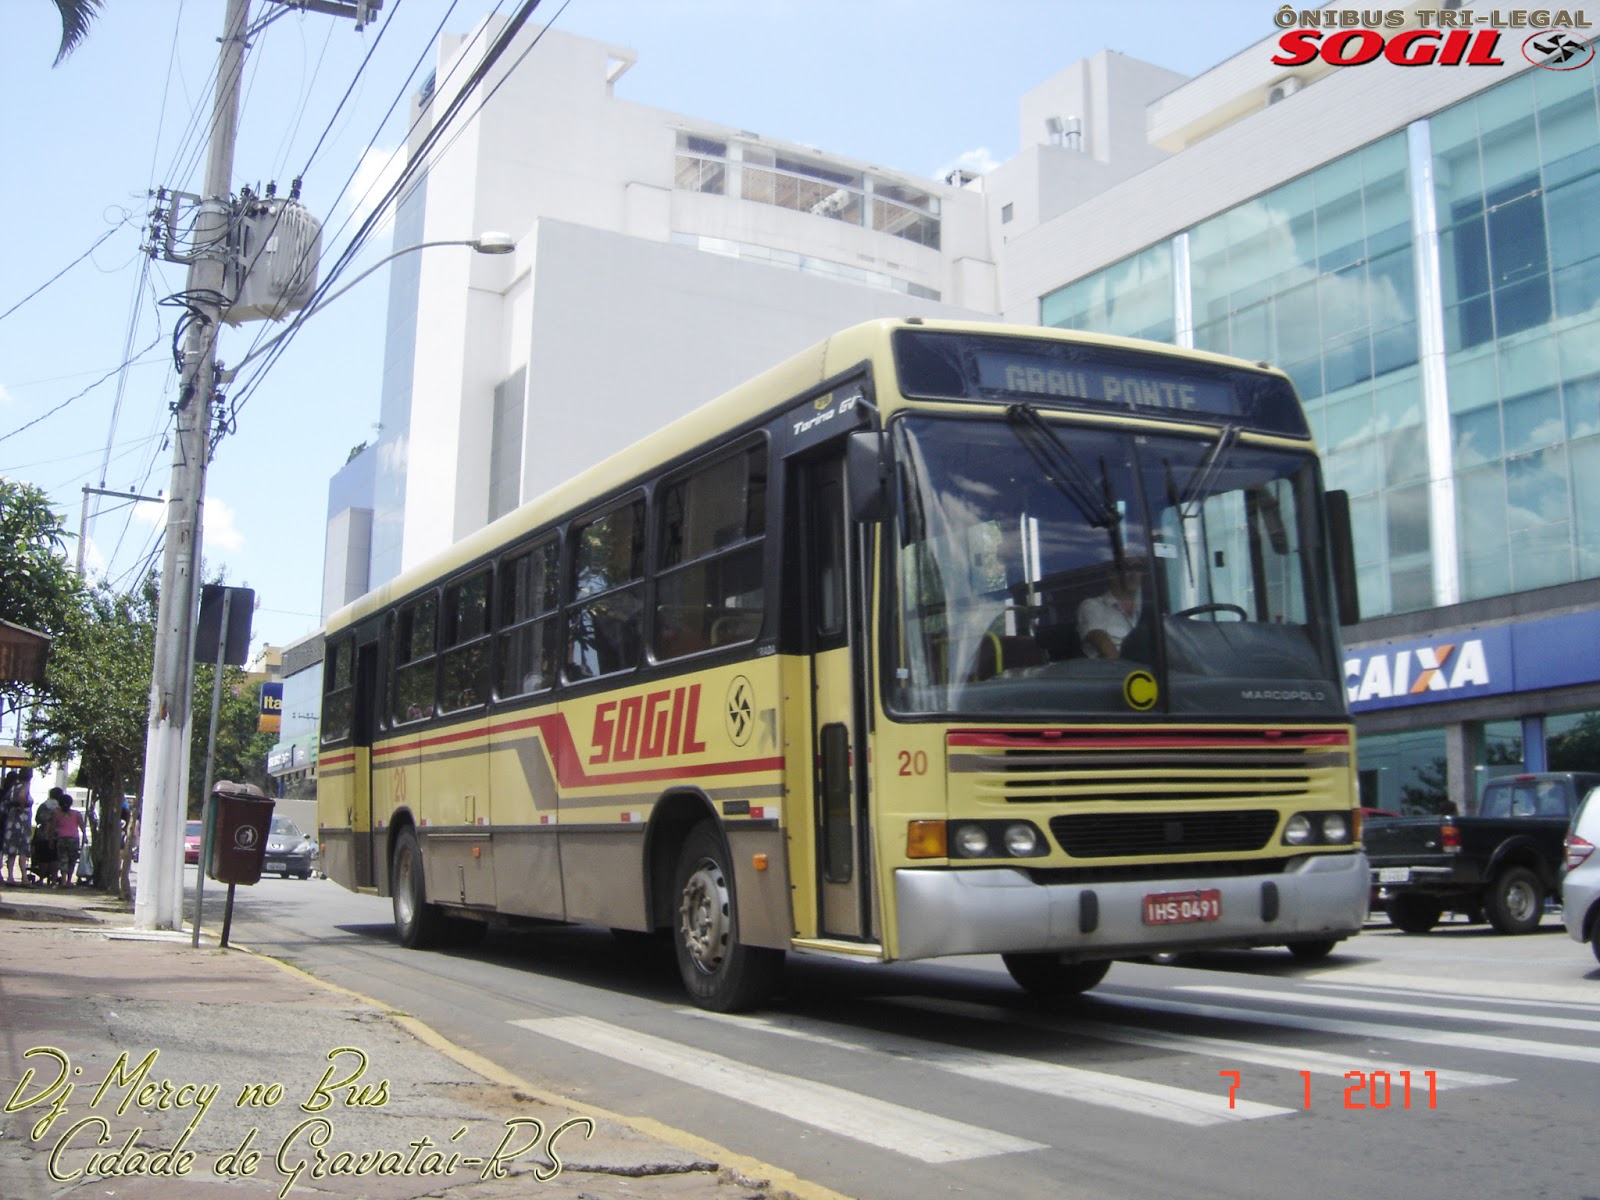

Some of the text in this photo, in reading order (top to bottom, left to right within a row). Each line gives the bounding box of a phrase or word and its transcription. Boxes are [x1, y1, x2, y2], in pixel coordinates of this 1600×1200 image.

[793, 409, 835, 435] Torino
[1344, 639, 1489, 703] CAIXA
[263, 695, 283, 710] Ita
[1240, 690, 1325, 701] MARCOPOLO
[588, 683, 706, 765] SOGIL
[898, 750, 928, 777] 20
[394, 767, 407, 802] 20
